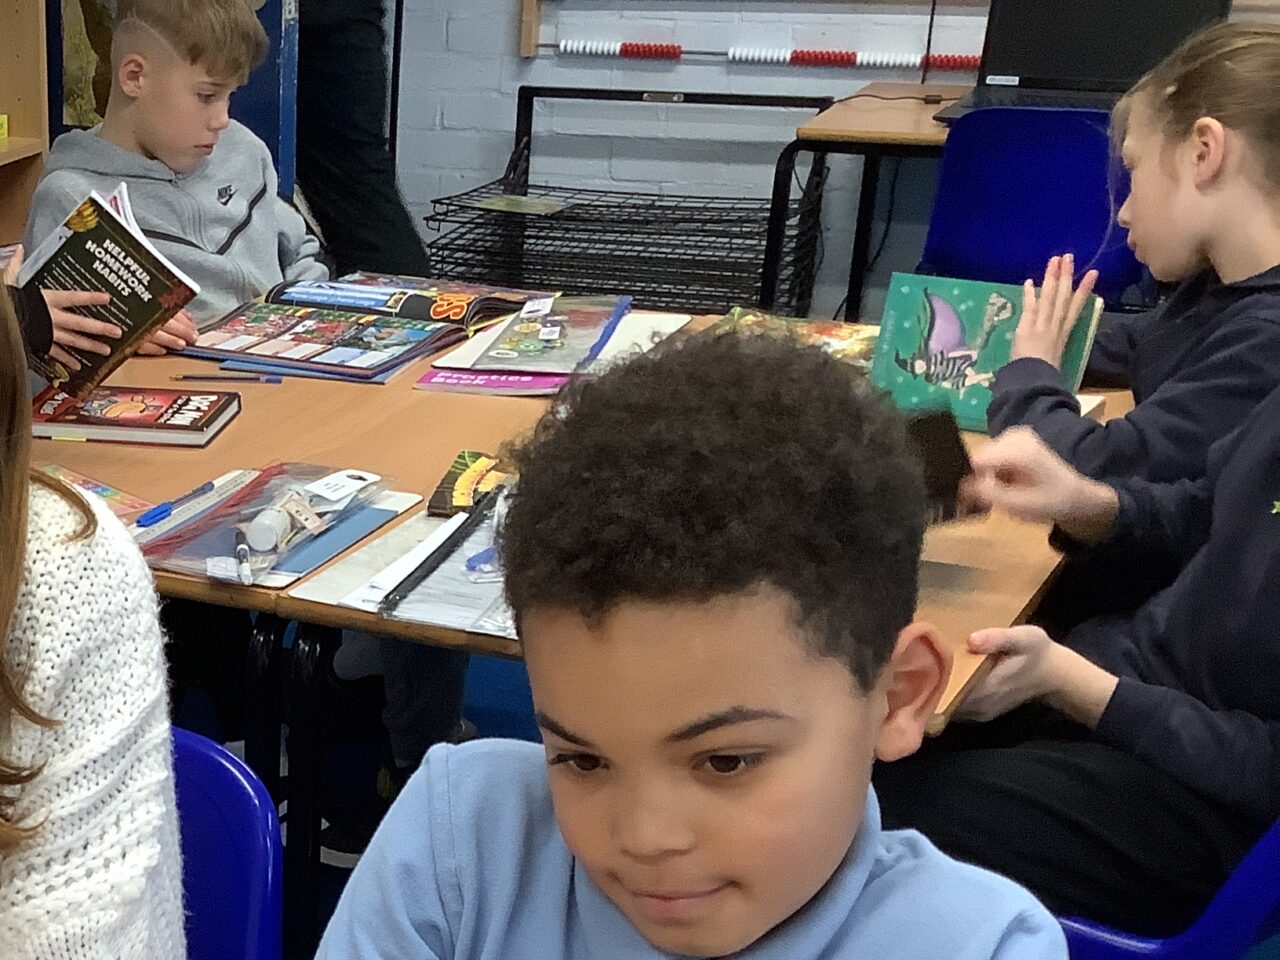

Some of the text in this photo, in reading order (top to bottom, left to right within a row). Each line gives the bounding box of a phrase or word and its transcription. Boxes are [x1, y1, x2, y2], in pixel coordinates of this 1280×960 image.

[85, 240, 153, 302] HOMEWORK
[92, 260, 132, 297] HABITS
[103, 239, 151, 286] HELPFUL
